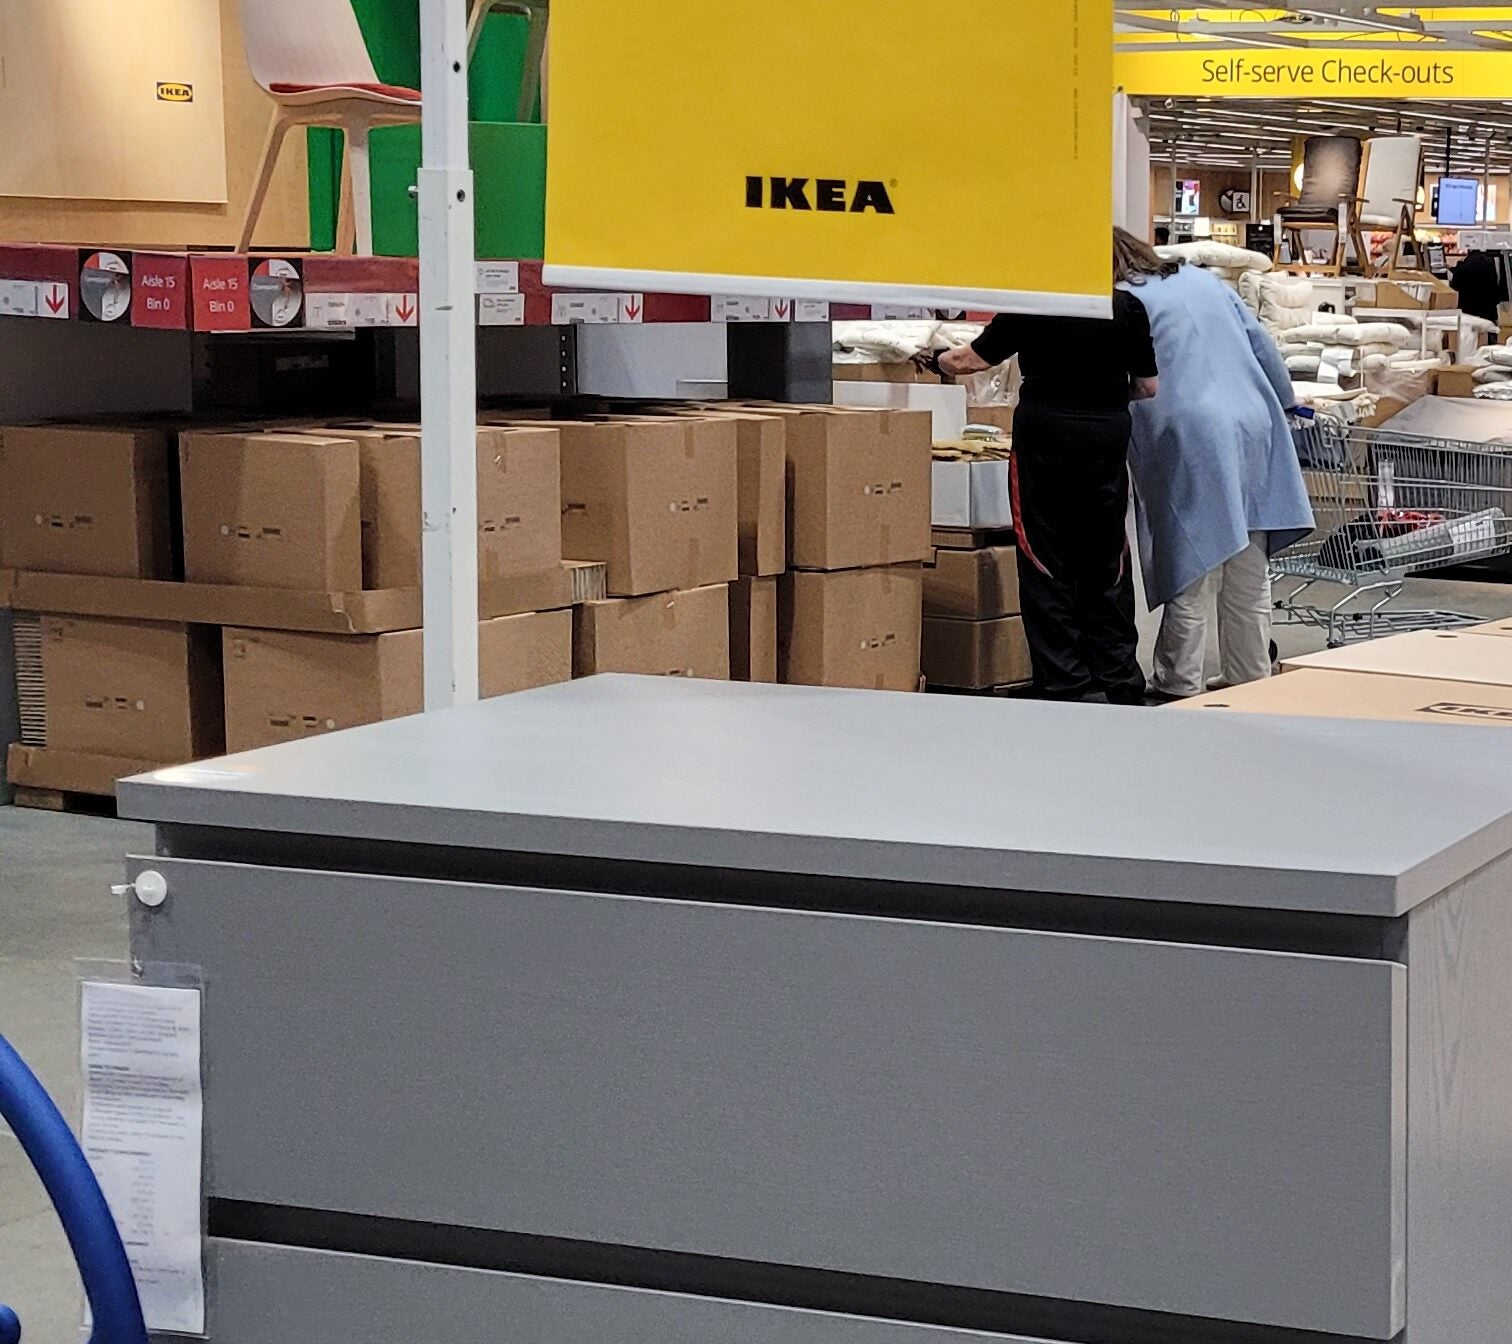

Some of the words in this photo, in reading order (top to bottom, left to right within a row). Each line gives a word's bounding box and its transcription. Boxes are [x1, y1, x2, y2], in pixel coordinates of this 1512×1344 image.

[1201, 58, 1314, 83] Self-serve
[1321, 58, 1454, 84] Check-outs
[745, 175, 896, 215] IKEA
[140, 275, 164, 289] Aisle
[164, 276, 176, 289] 15
[202, 277, 226, 290] Aisle
[227, 278, 239, 291] 15
[146, 297, 163, 310] Bin
[163, 298, 170, 311] 0
[209, 300, 225, 313] Bin
[227, 300, 235, 313] 0
